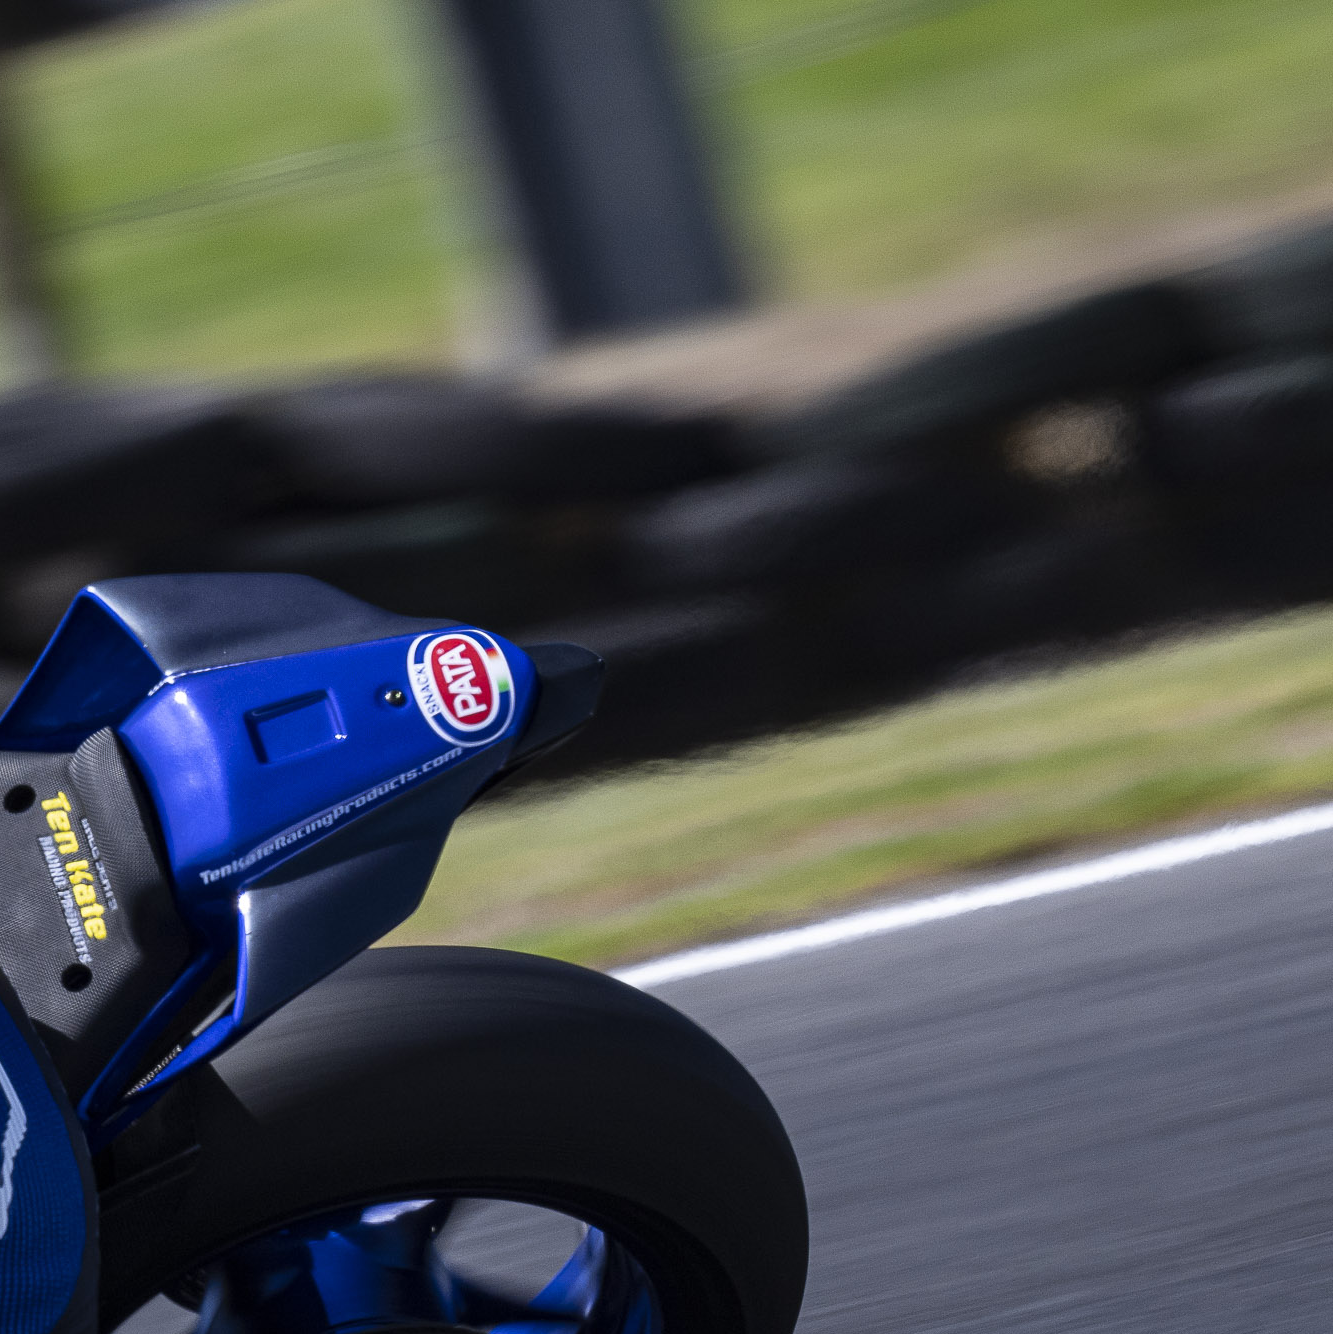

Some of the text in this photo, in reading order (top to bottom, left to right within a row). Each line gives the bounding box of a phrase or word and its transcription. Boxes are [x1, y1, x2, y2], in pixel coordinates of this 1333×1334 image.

[415, 663, 439, 716] SNACK
[440, 642, 482, 716] PATA
[41, 791, 107, 939] Ten Kate
[199, 745, 464, 885] TenKateRacingProducts.com
